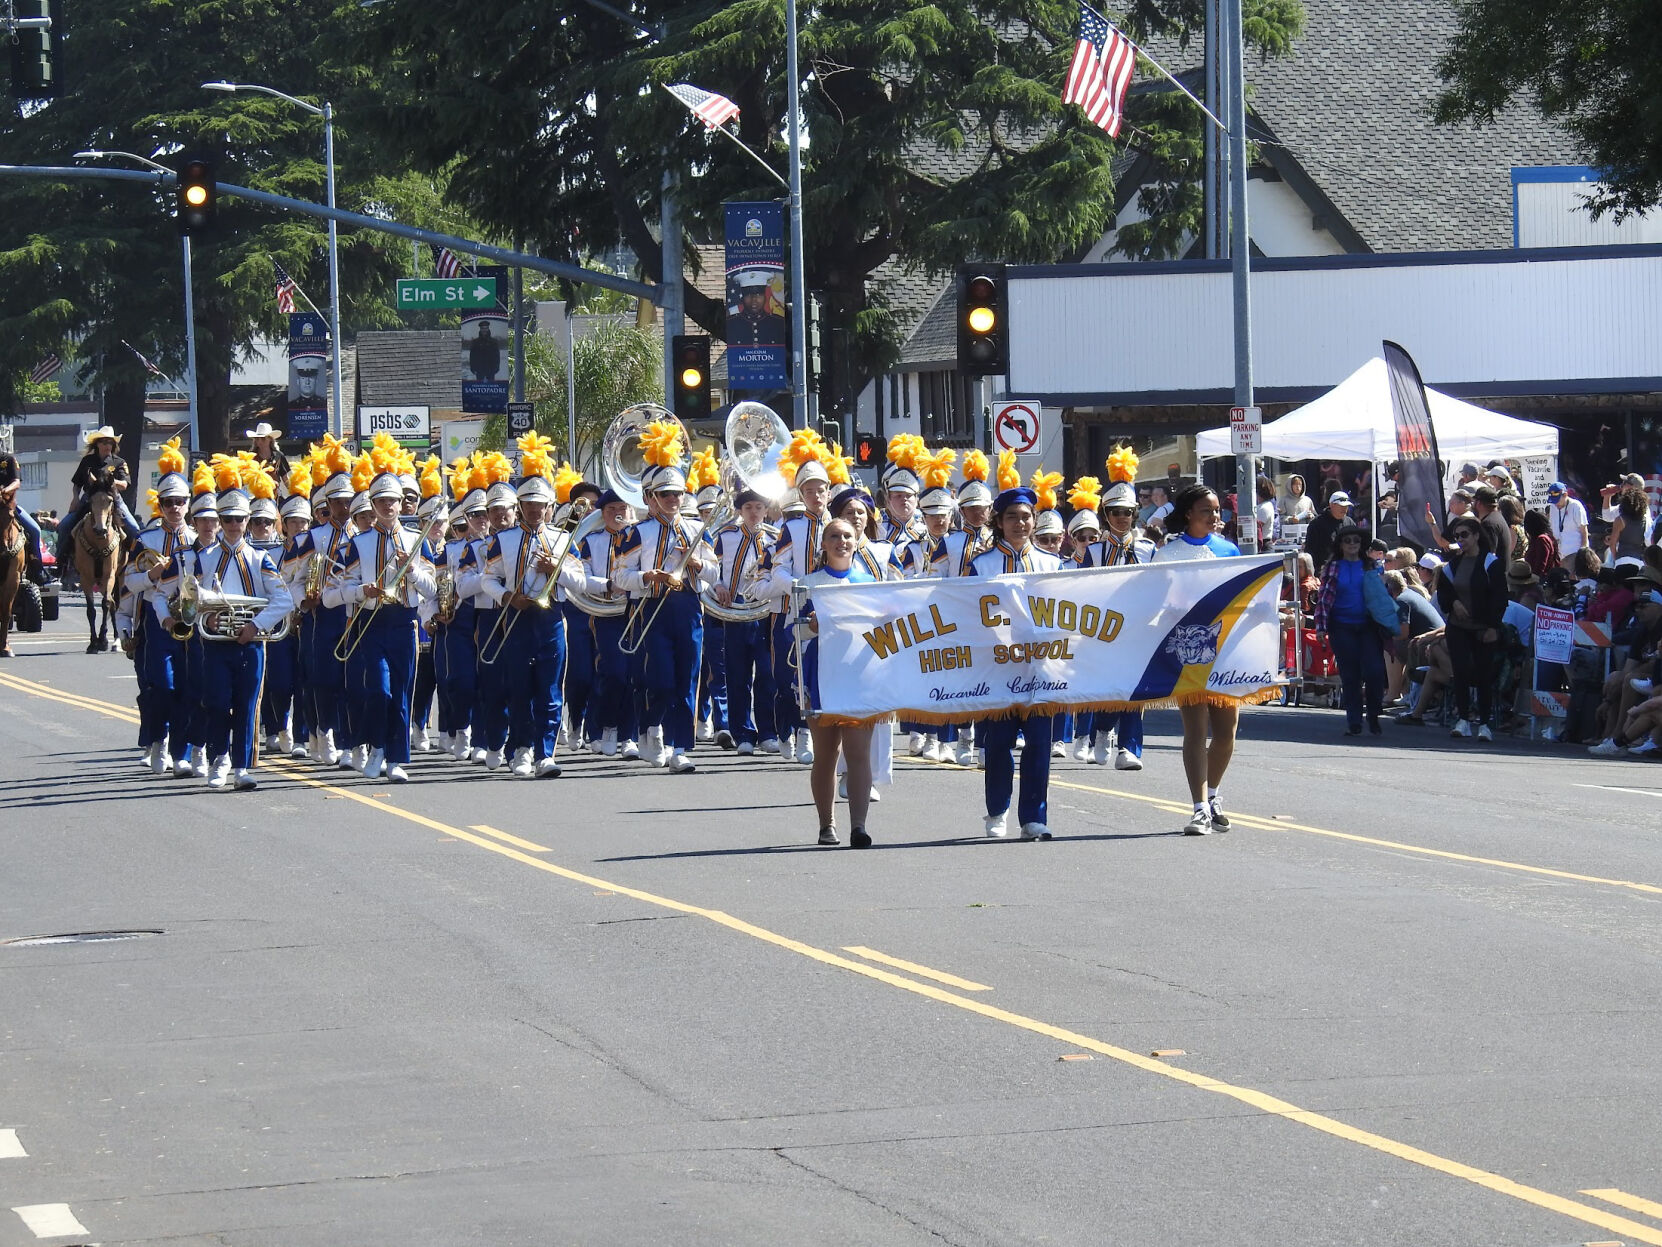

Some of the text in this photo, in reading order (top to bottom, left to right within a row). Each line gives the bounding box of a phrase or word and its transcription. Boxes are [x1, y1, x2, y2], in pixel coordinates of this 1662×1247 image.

[727, 238, 781, 247] VACAVILLE
[402, 286, 465, 302] Elm St
[738, 354, 774, 362] MORTON
[370, 410, 402, 433] psbs
[1231, 409, 1244, 421] NO
[513, 418, 527, 427] 40
[1233, 423, 1259, 432] PARKING
[1240, 433, 1253, 441] ANY
[1240, 441, 1254, 449] TIME
[862, 594, 1125, 660] WILL C. WOOD
[1537, 617, 1573, 632] NO PARKING
[919, 638, 1074, 674] HIGH SCHOOL
[1208, 670, 1272, 687] Wildcats
[929, 681, 991, 702] Vacaville
